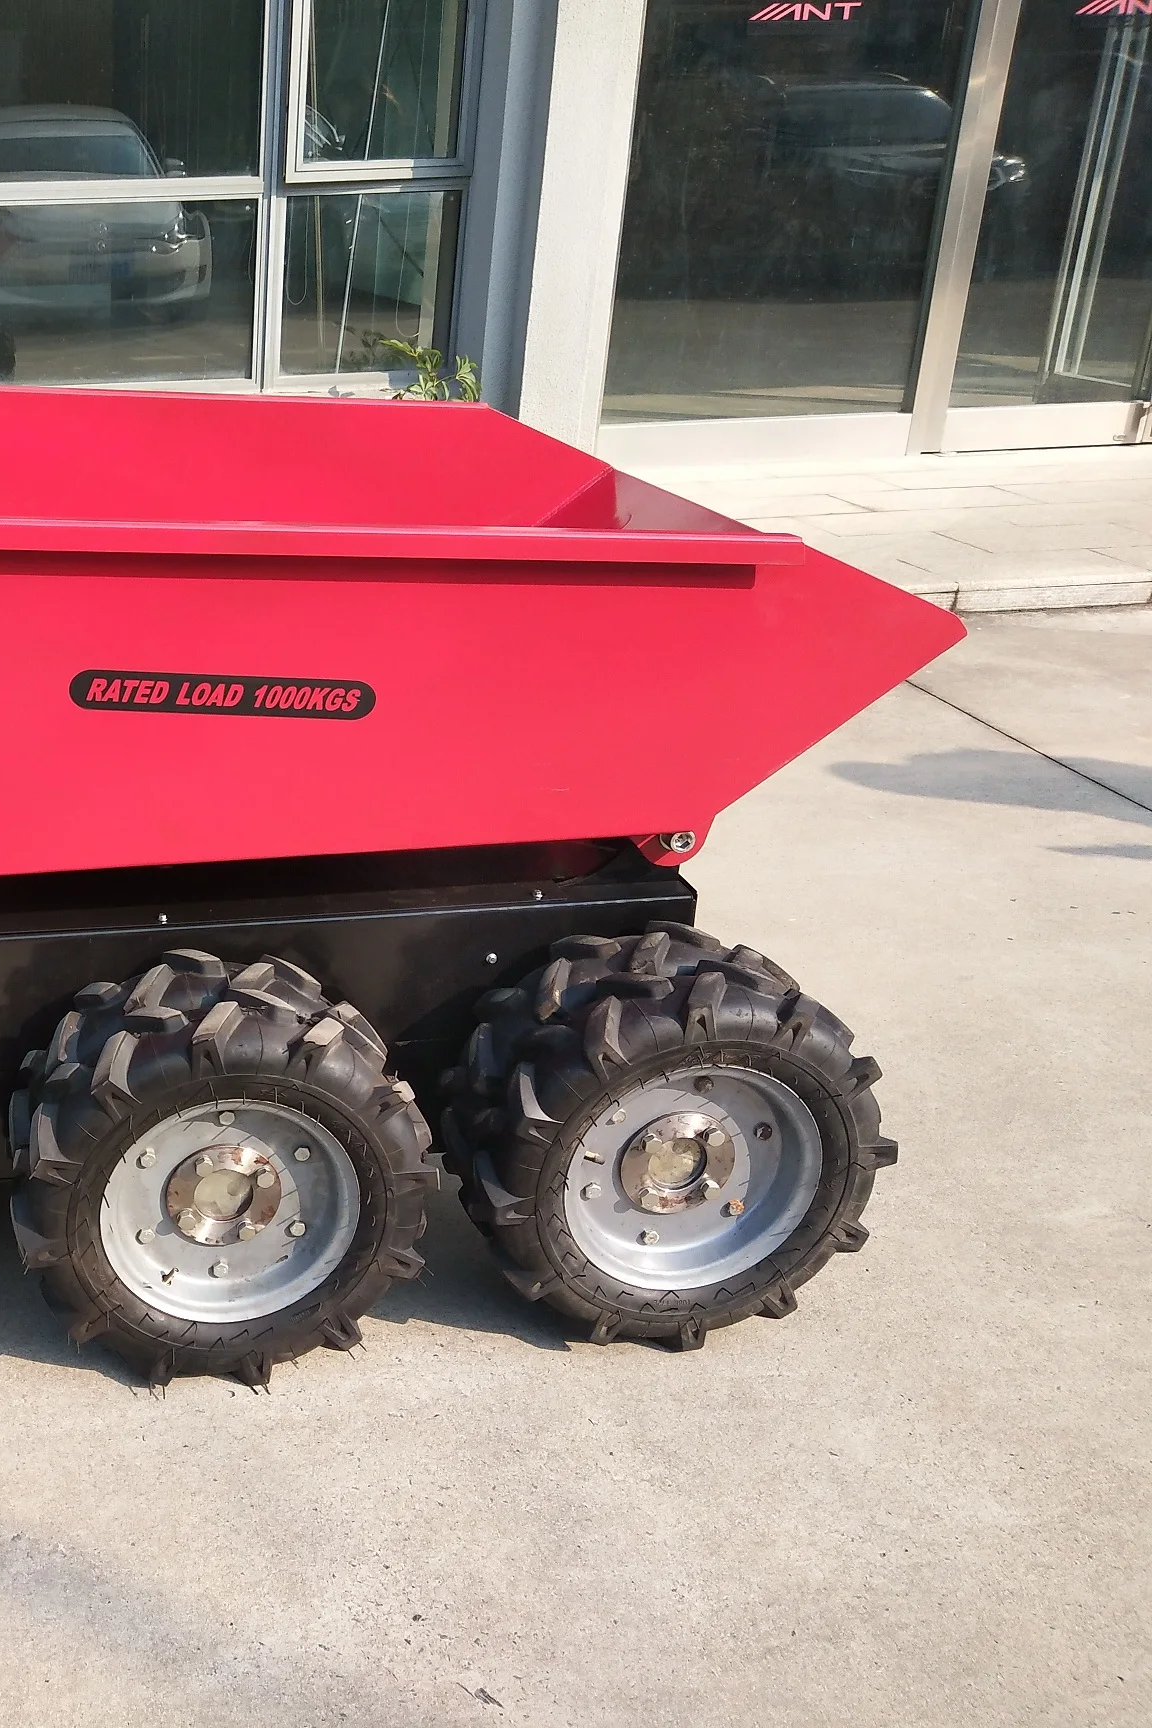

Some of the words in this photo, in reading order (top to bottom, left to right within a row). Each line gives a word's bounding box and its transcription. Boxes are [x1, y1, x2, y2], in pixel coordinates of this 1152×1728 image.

[85, 677, 170, 704] RATED
[175, 681, 245, 707] LOAD
[253, 684, 362, 712] 1000KGS
